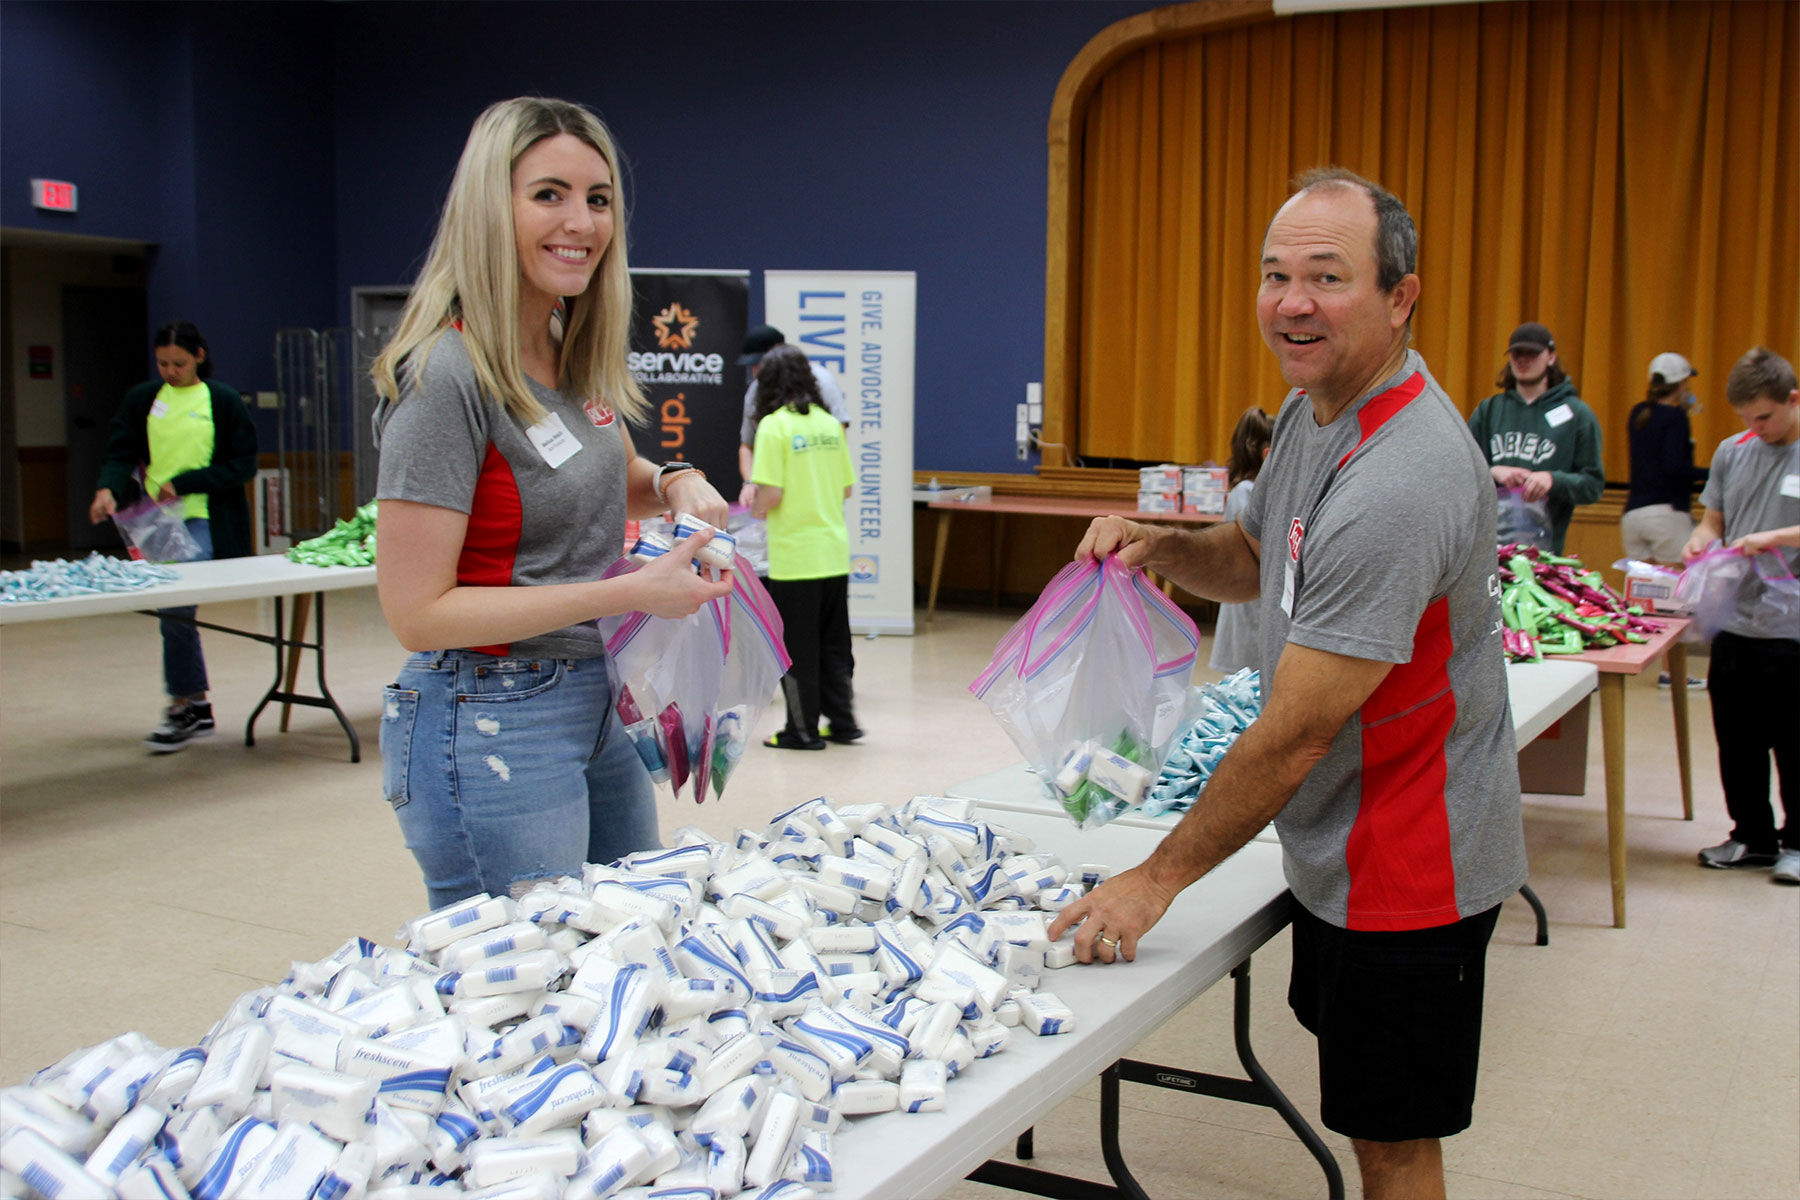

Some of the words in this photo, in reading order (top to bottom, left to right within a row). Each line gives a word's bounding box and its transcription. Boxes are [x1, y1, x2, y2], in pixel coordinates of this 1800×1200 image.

[43, 181, 73, 209] EXIT
[861, 291, 882, 336] GIVE.
[627, 352, 723, 373] service
[860, 341, 882, 434] ADVOCATE.
[860, 441, 881, 544] VOLUNTEER.
[584, 1001, 608, 1048] freshscent
[848, 1004, 888, 1029] freshscent
[353, 1048, 413, 1070] freshscent
[787, 1052, 826, 1081] freshscent
[479, 1065, 525, 1094] freshscent
[551, 1084, 596, 1111] freshscent
